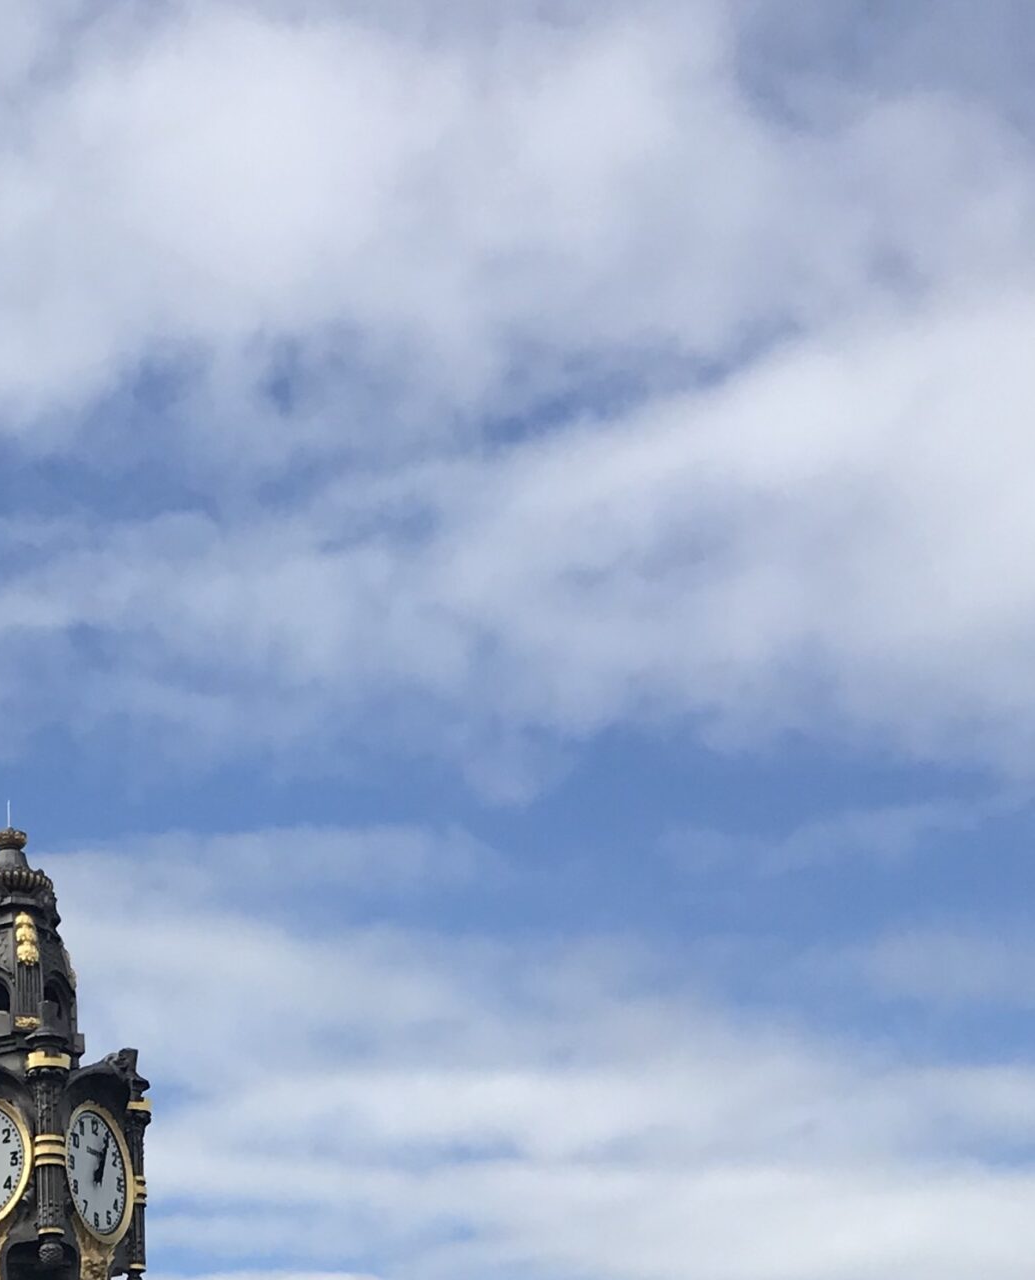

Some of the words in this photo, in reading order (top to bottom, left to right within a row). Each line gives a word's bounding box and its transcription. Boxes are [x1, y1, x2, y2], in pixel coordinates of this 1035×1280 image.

[2, 1129, 11, 1143] 2
[10, 1151, 18, 1166] 3
[3, 1176, 12, 1190] 4
[83, 1199, 88, 1215] 7
[113, 1199, 118, 1212] 4
[94, 1212, 99, 1227] 6
[106, 1211, 111, 1225] 5
